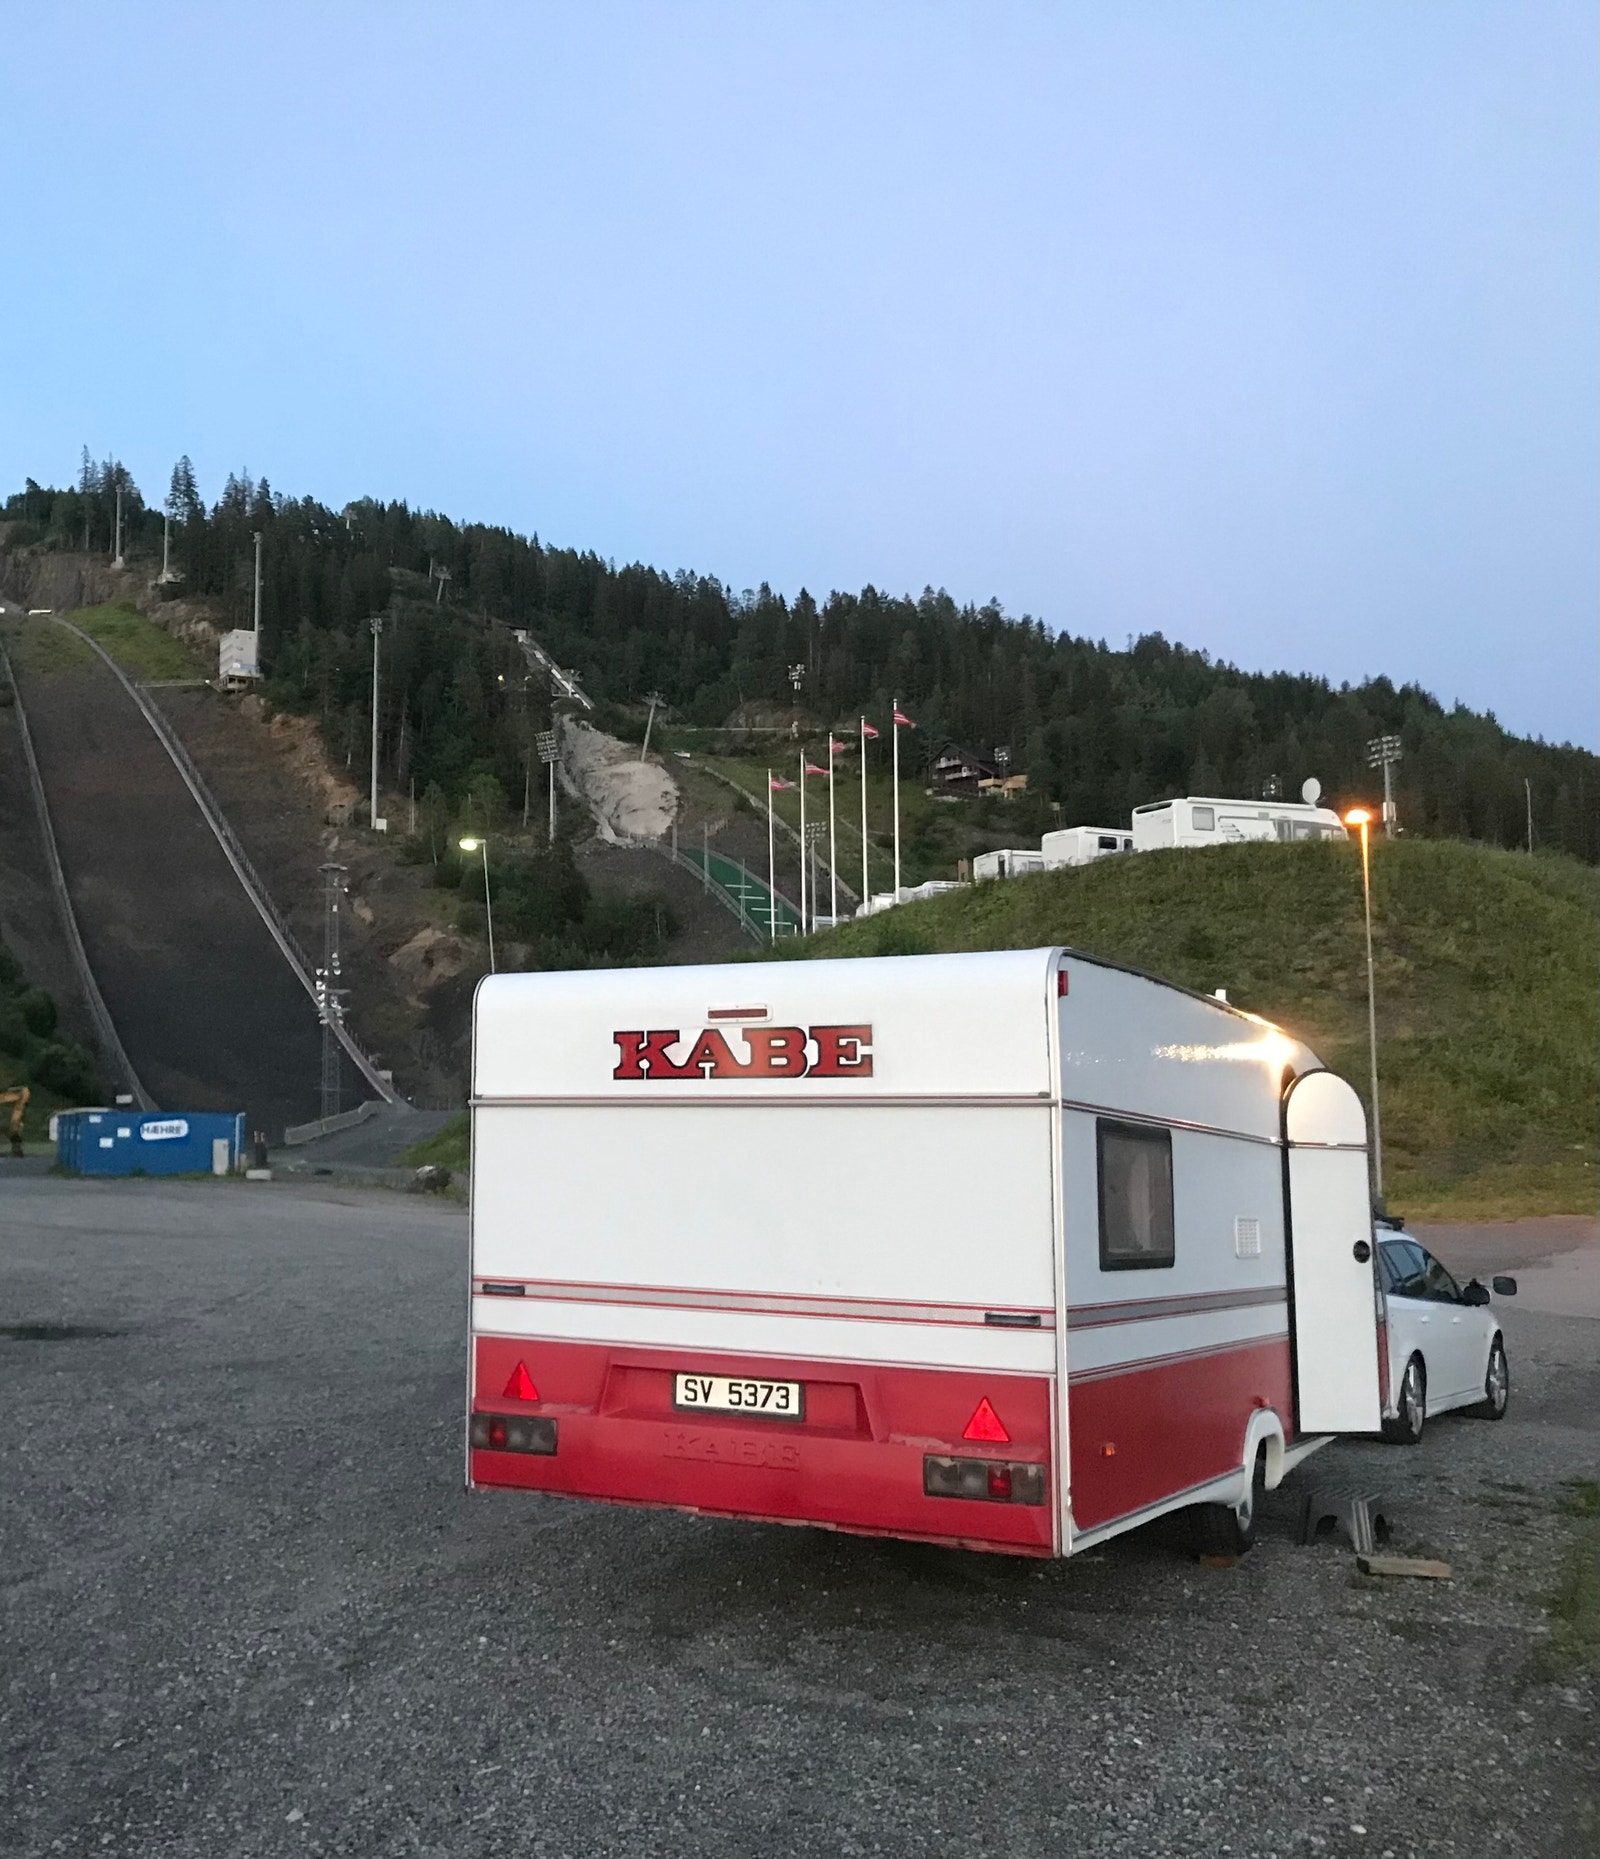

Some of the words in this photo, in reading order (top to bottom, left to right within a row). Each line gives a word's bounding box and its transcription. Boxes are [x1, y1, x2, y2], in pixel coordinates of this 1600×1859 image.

[613, 1024, 874, 1080] KABE
[684, 1378, 713, 1404] SV
[728, 1382, 790, 1410] 5373
[663, 1432, 800, 1472] KABE
